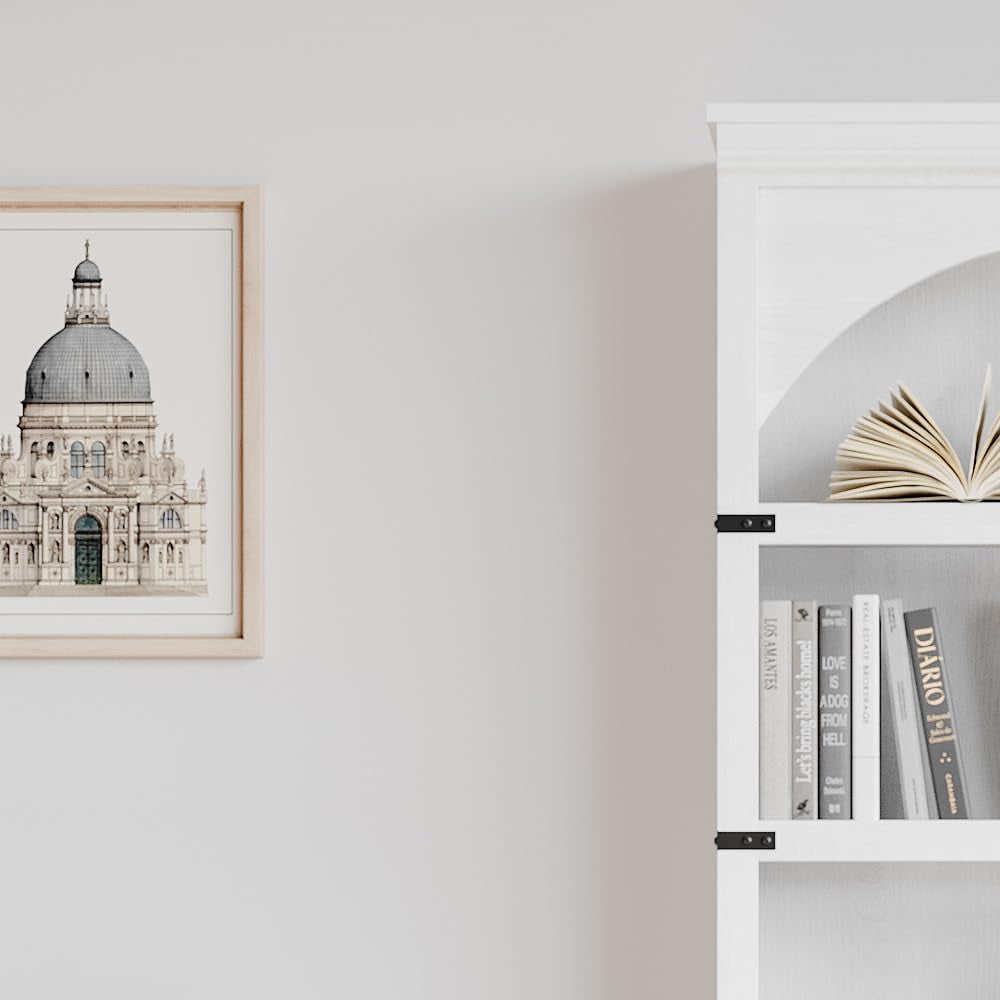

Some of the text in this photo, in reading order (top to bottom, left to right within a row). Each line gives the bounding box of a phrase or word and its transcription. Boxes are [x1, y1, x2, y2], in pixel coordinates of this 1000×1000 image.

[764, 618, 778, 691] LOS AMANTES
[822, 656, 847, 670] LOVE
[914, 627, 946, 706] DIÁRIO
[828, 675, 839, 689] IS
[795, 640, 816, 783] Let's bring blacks home!
[821, 713, 848, 728] FROM
[822, 732, 847, 746] HELL
